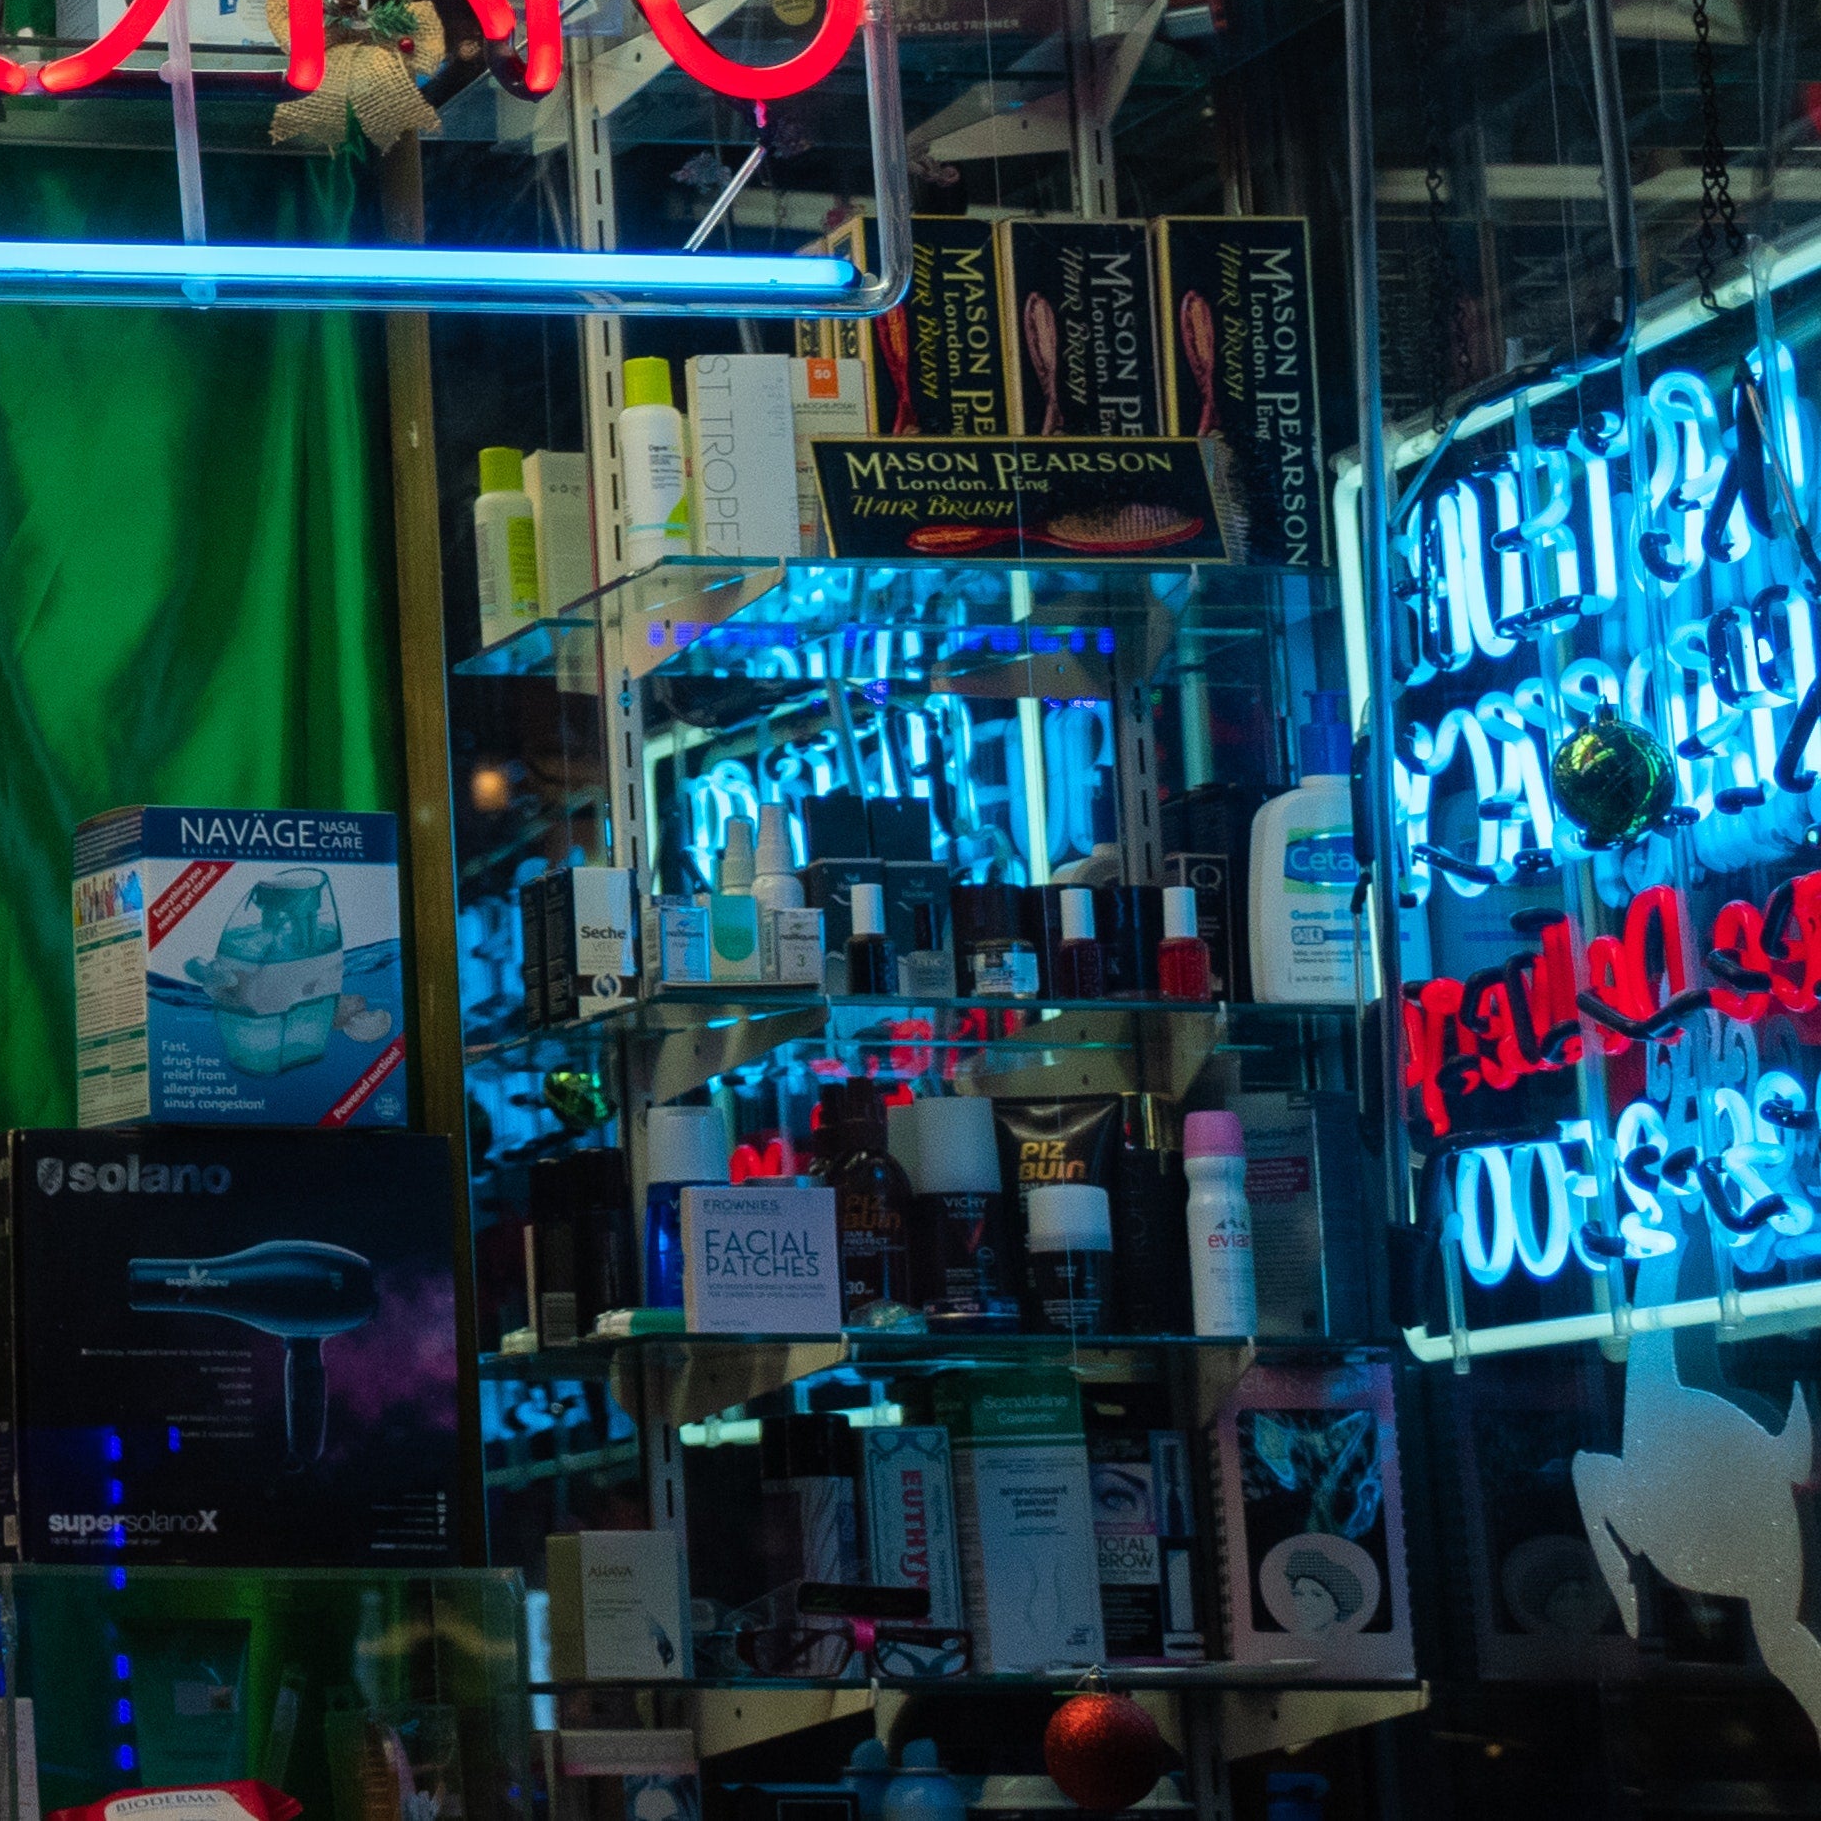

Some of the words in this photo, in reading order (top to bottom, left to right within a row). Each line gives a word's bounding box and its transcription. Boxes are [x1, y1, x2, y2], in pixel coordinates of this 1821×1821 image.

[941, 246, 991, 376] MASON
[1089, 252, 1138, 381] MASON
[1249, 247, 1299, 377] MASON
[917, 315, 943, 400] BRUSH
[845, 452, 980, 490] MASON
[991, 452, 1173, 491] PEARSON
[1255, 391, 1309, 566] PEARSON
[852, 495, 920, 521] HAIR
[927, 492, 1015, 520] BRUSH
[180, 812, 316, 849] NAVÄGE
[318, 821, 363, 835] NASAL
[319, 835, 364, 850] CARE
[581, 926, 626, 940] Seche
[162, 1054, 221, 1069] drug-free
[163, 1069, 193, 1081] relief
[196, 1070, 226, 1081] from
[163, 1084, 213, 1098] allergies
[217, 1084, 237, 1096] and
[164, 1098, 193, 1110] sinus
[196, 1098, 266, 1113] congestion!
[67, 1154, 233, 1196] solano
[703, 1199, 778, 1211] FROWNIES
[943, 1197, 987, 1209] VICHY
[704, 1230, 819, 1255] FACIAL
[706, 1256, 820, 1277] PATCHES
[1098, 1536, 1147, 1553] TOTAL
[1098, 1552, 1153, 1569] BROW
